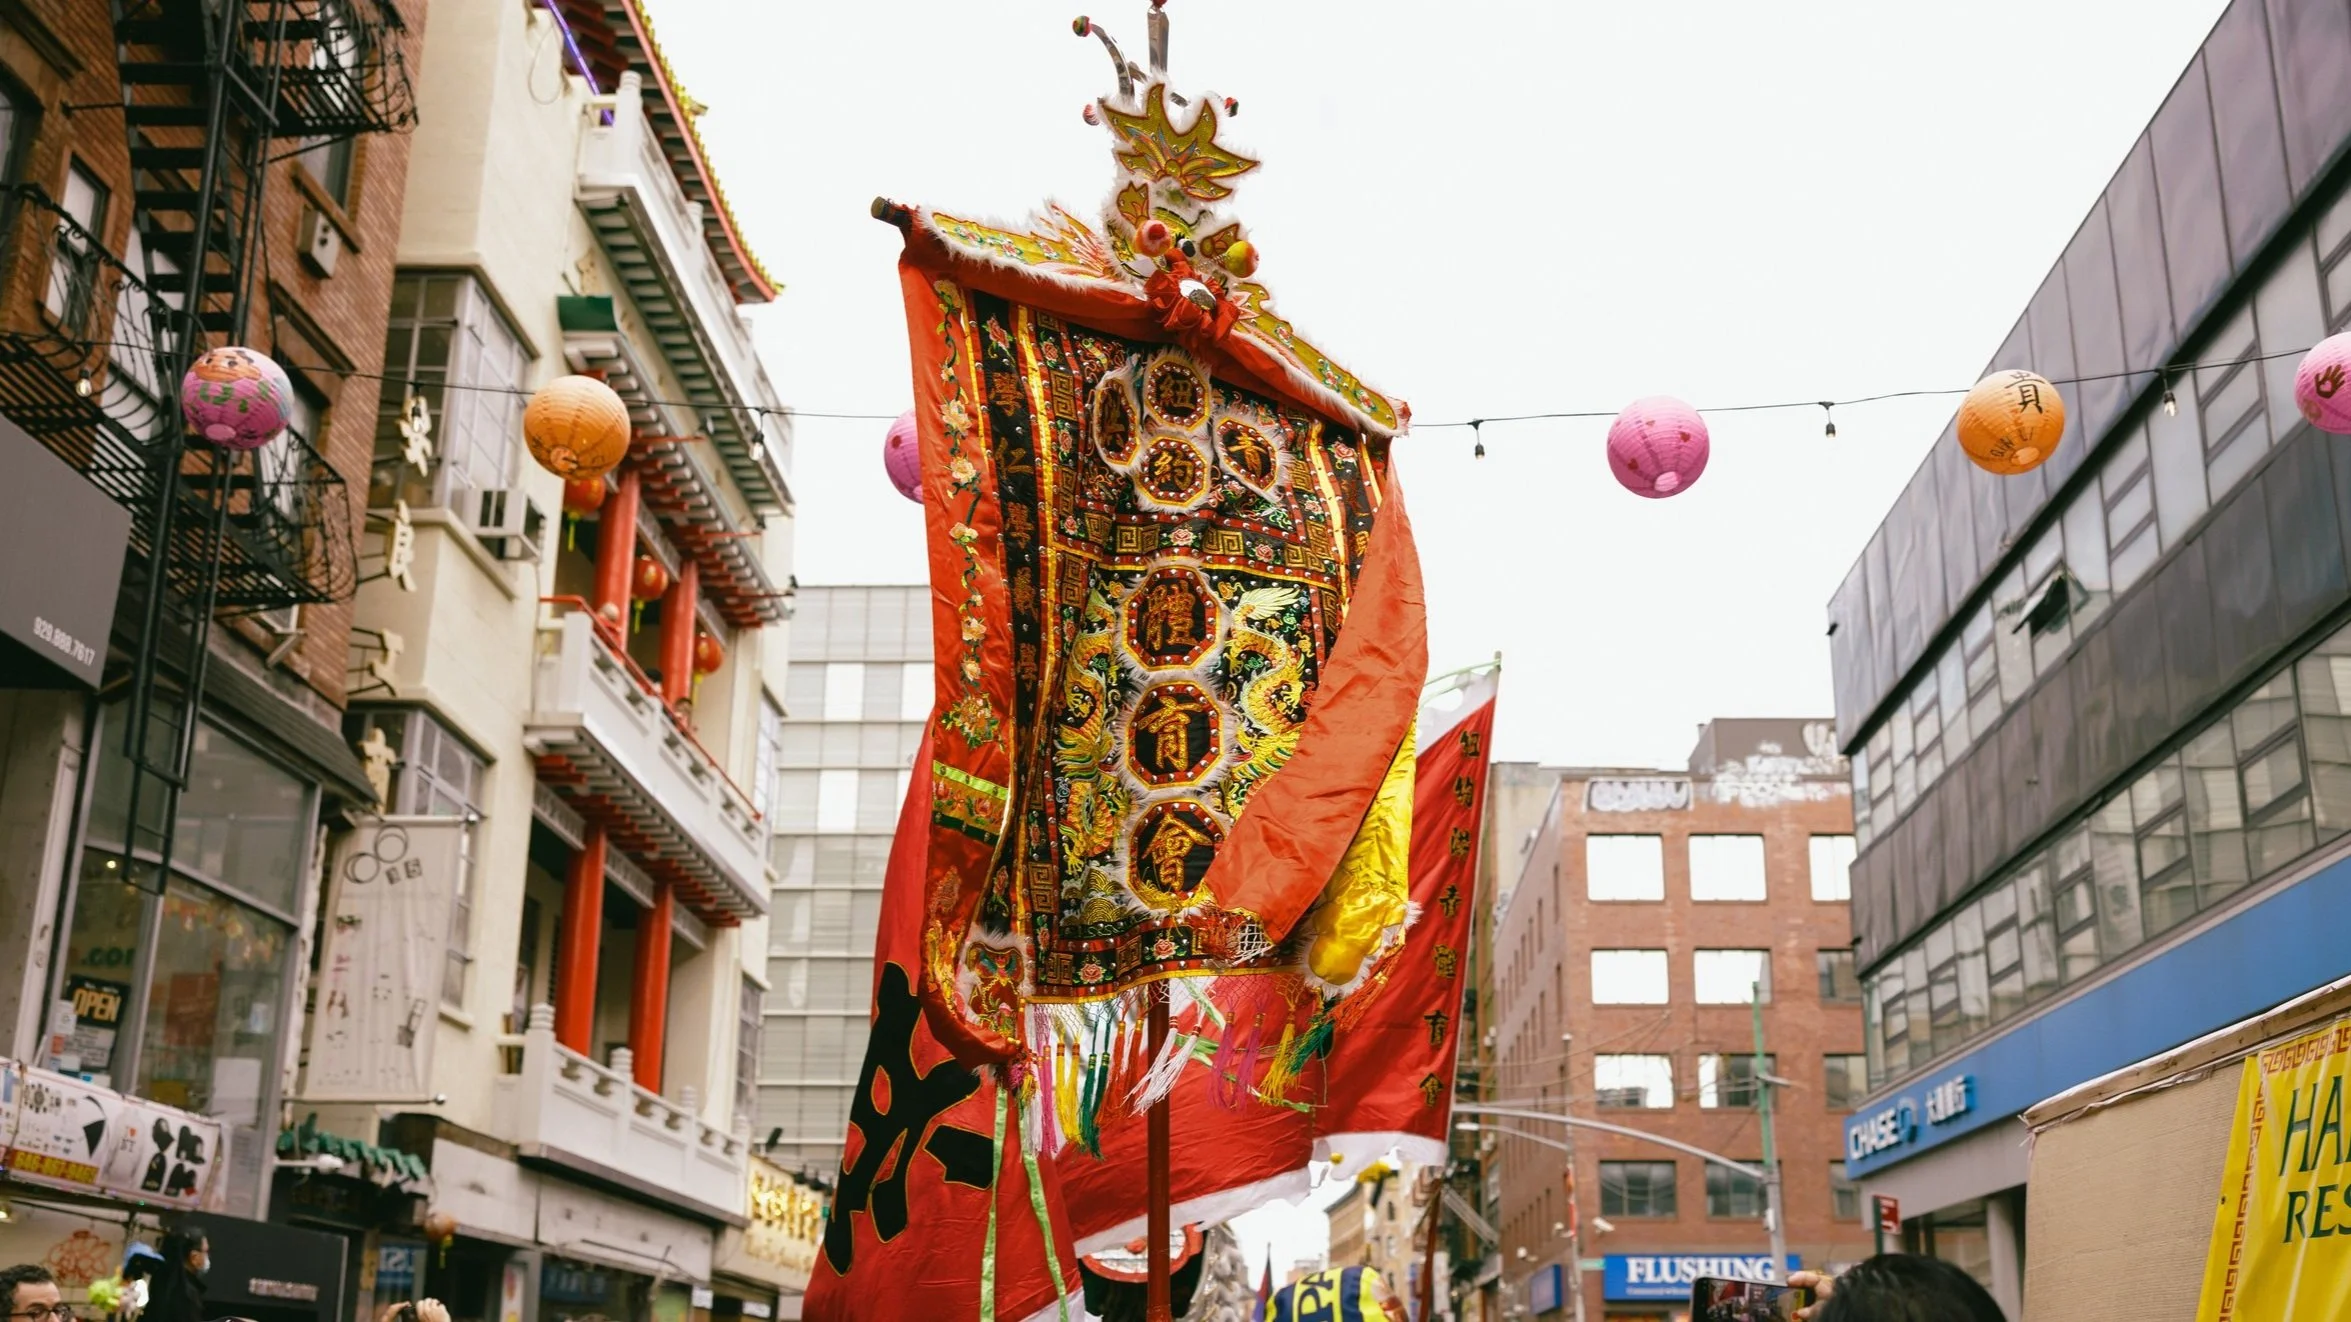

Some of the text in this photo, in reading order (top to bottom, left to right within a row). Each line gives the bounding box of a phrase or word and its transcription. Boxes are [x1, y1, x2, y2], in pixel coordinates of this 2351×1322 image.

[73, 987, 121, 1022] OPEN
[1850, 1108, 1899, 1161] CHASE
[2278, 1075, 2351, 1177] HA
[1626, 1257, 1775, 1284] FLUSHING
